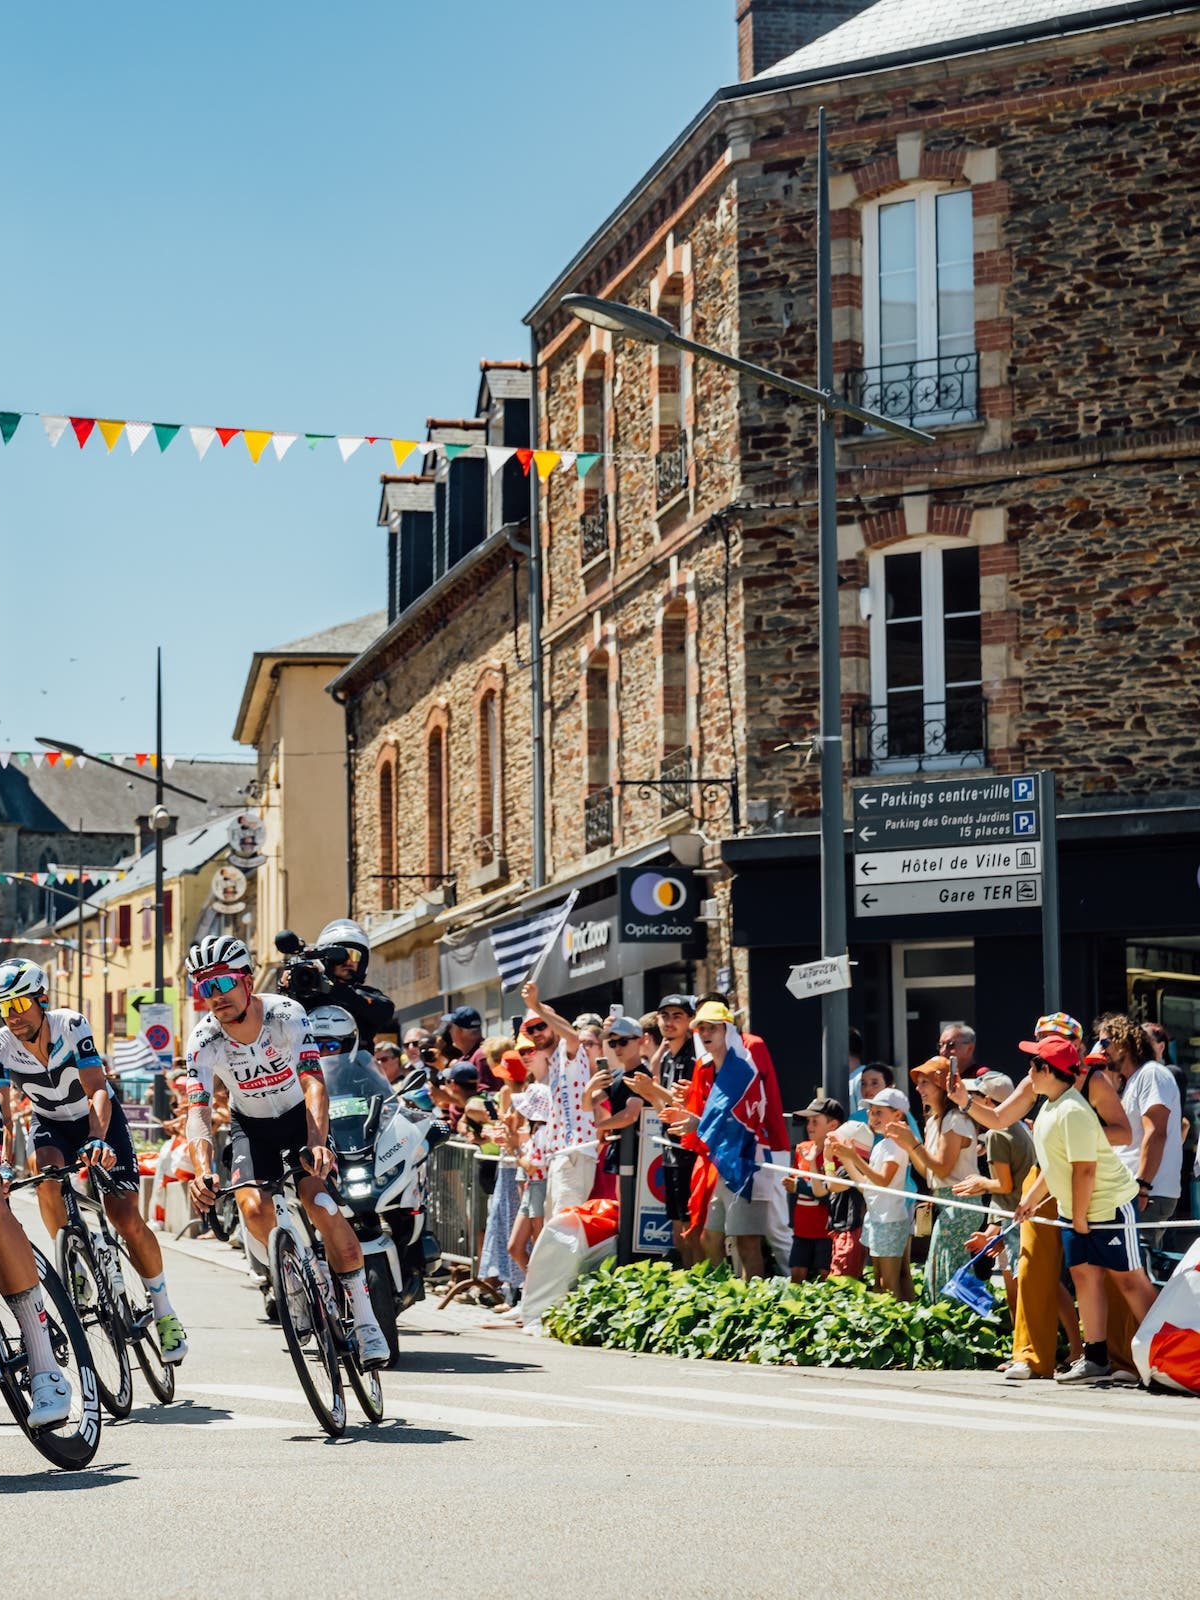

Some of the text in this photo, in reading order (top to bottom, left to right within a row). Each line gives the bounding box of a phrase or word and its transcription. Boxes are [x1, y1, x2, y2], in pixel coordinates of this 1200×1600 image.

[881, 791, 934, 808] Parkings
[939, 784, 1010, 802] centre-ville
[885, 817, 919, 831] Parking
[922, 816, 938, 827] des
[941, 813, 973, 826] Grands
[975, 811, 1010, 824] Jardins
[959, 825, 1010, 839] 15 places
[902, 853, 1011, 874] Hôtel de Ville
[939, 885, 1012, 903] Gare TER
[625, 923, 659, 938] Optic
[234, 1057, 288, 1082] UAE
[243, 1073, 289, 1089] Emirates
